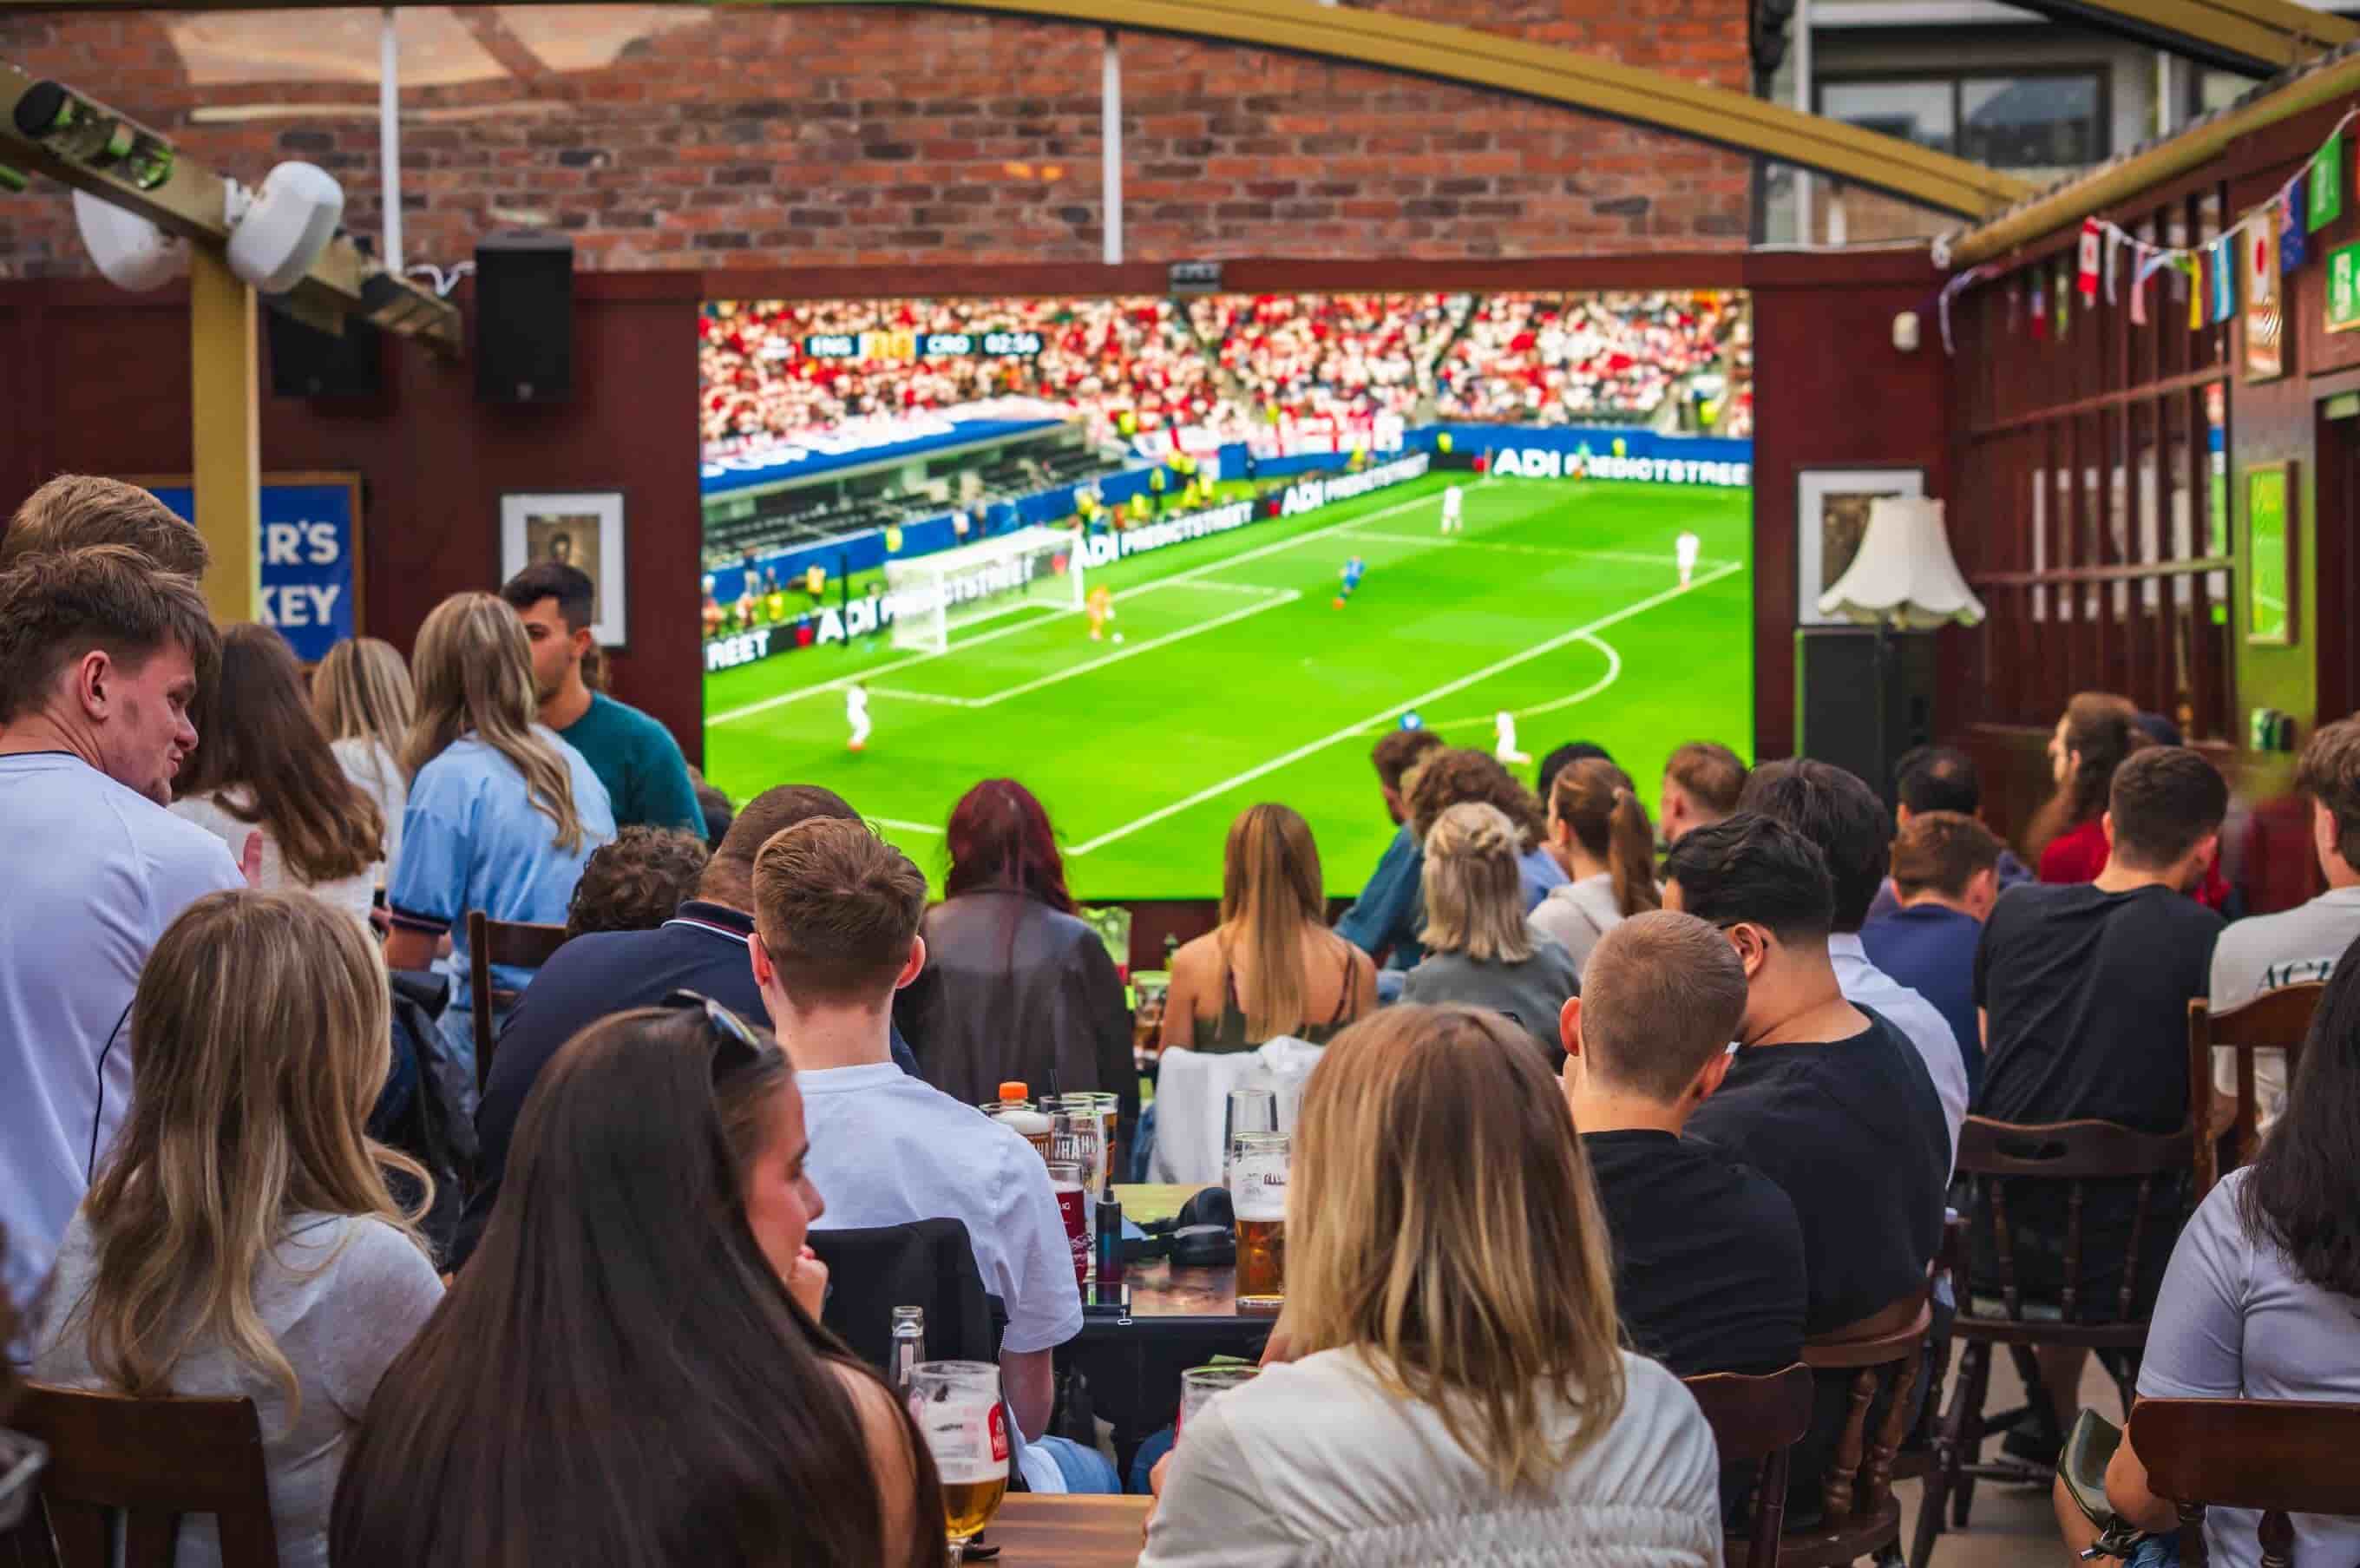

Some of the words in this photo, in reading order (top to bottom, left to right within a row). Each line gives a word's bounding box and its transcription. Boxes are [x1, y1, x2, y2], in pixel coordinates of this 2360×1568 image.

[1494, 448, 1560, 478] ADI
[1281, 480, 1324, 518] ADI
[261, 518, 339, 565] R'S
[816, 594, 878, 644] ADI
